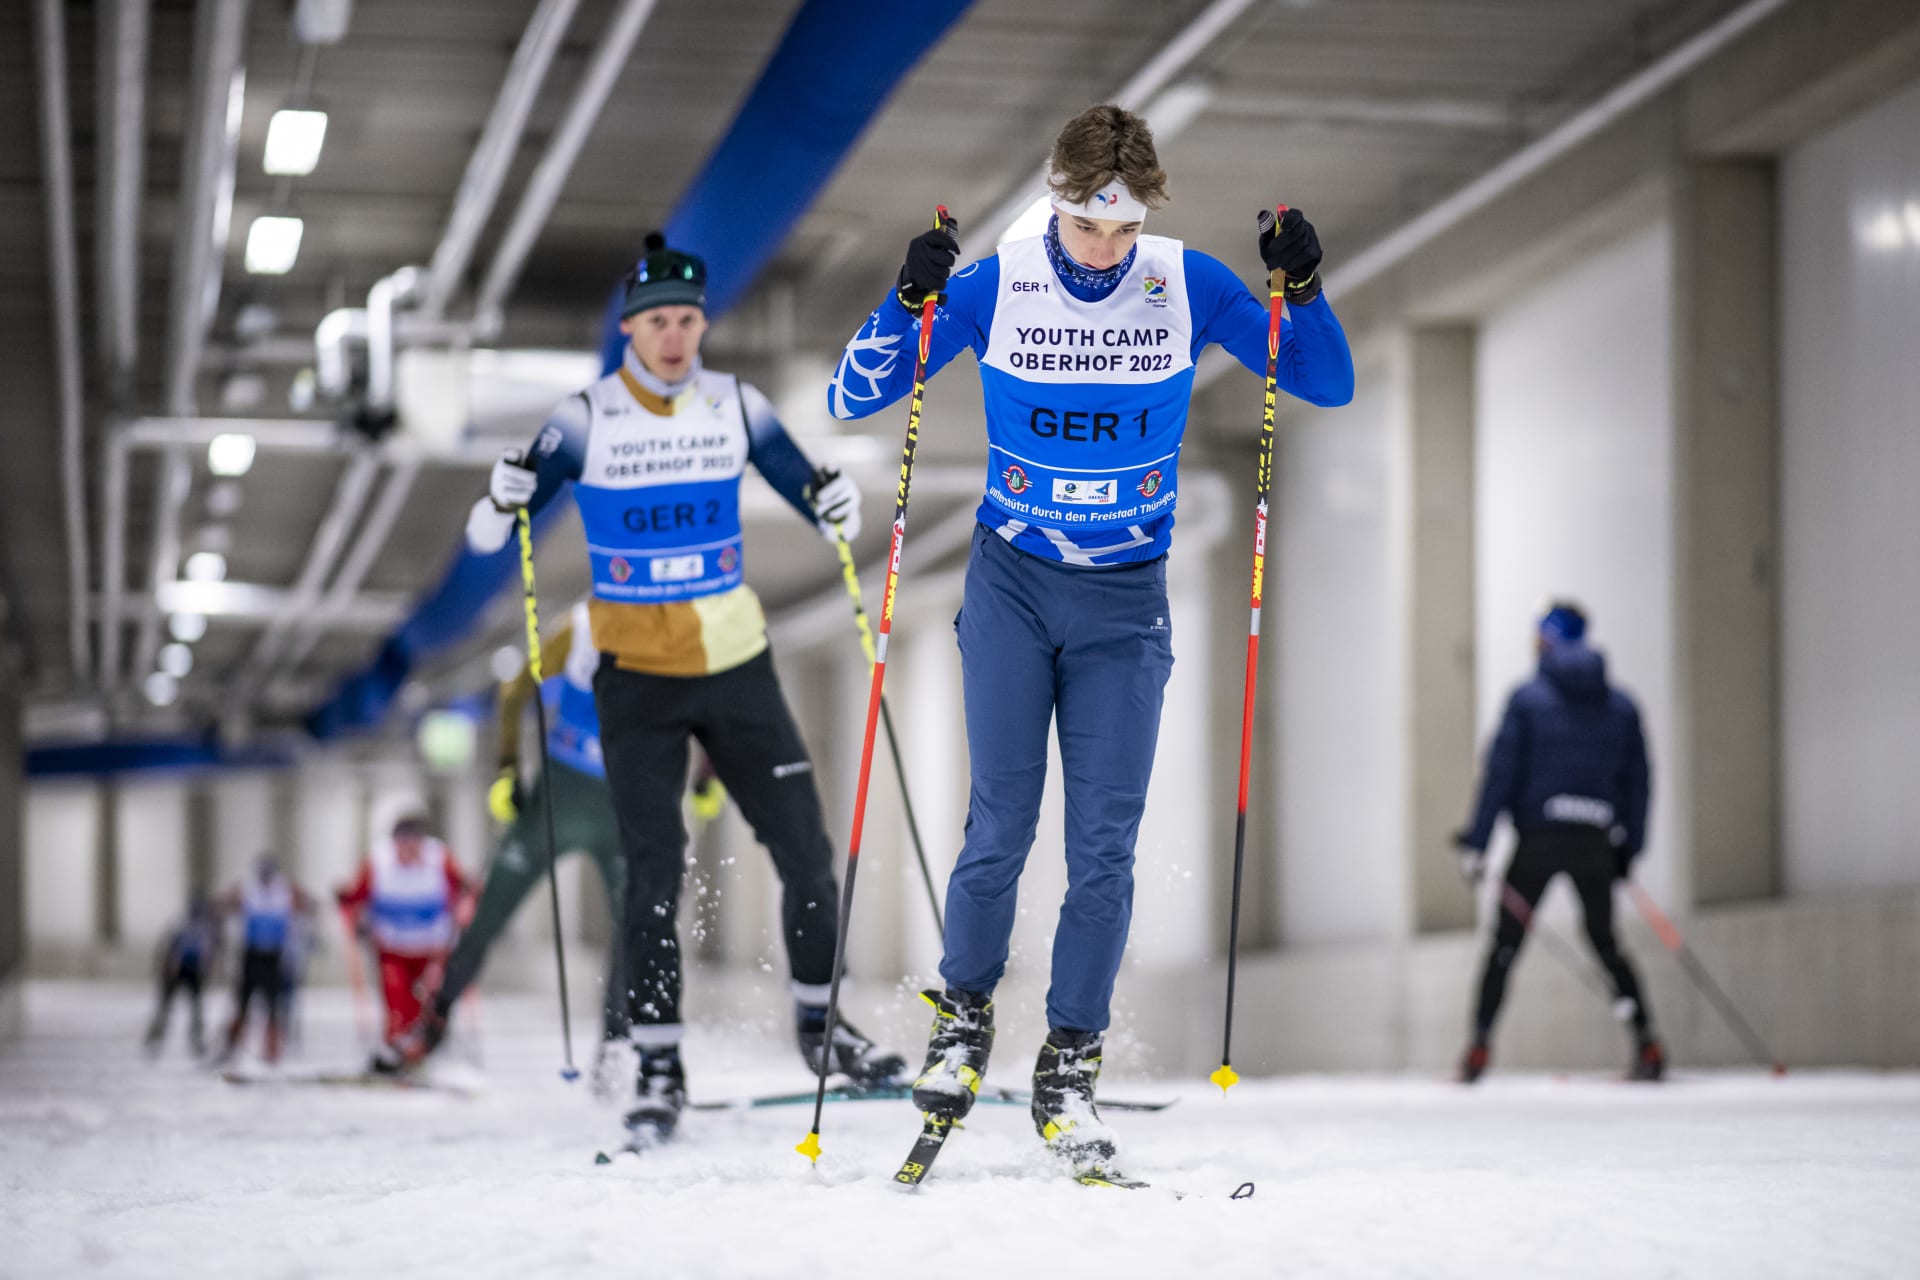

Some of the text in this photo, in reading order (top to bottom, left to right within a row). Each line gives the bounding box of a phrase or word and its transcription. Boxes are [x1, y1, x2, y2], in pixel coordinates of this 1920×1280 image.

[1012, 281, 1049, 293] GER 1
[1016, 327, 1169, 346] YOUTH CAMP
[1009, 352, 1172, 371] OBERHOF 2022
[908, 382, 925, 442] LEKI
[1264, 376, 1276, 432] LEKI
[1030, 407, 1149, 442] GER 1
[611, 435, 728, 456] YOUTH CAMP
[605, 457, 695, 478] OBERHOF
[623, 500, 721, 533] GER 2
[1031, 505, 1062, 520] durch
[1065, 511, 1087, 522] den
[1090, 506, 1137, 522] Freistaat
